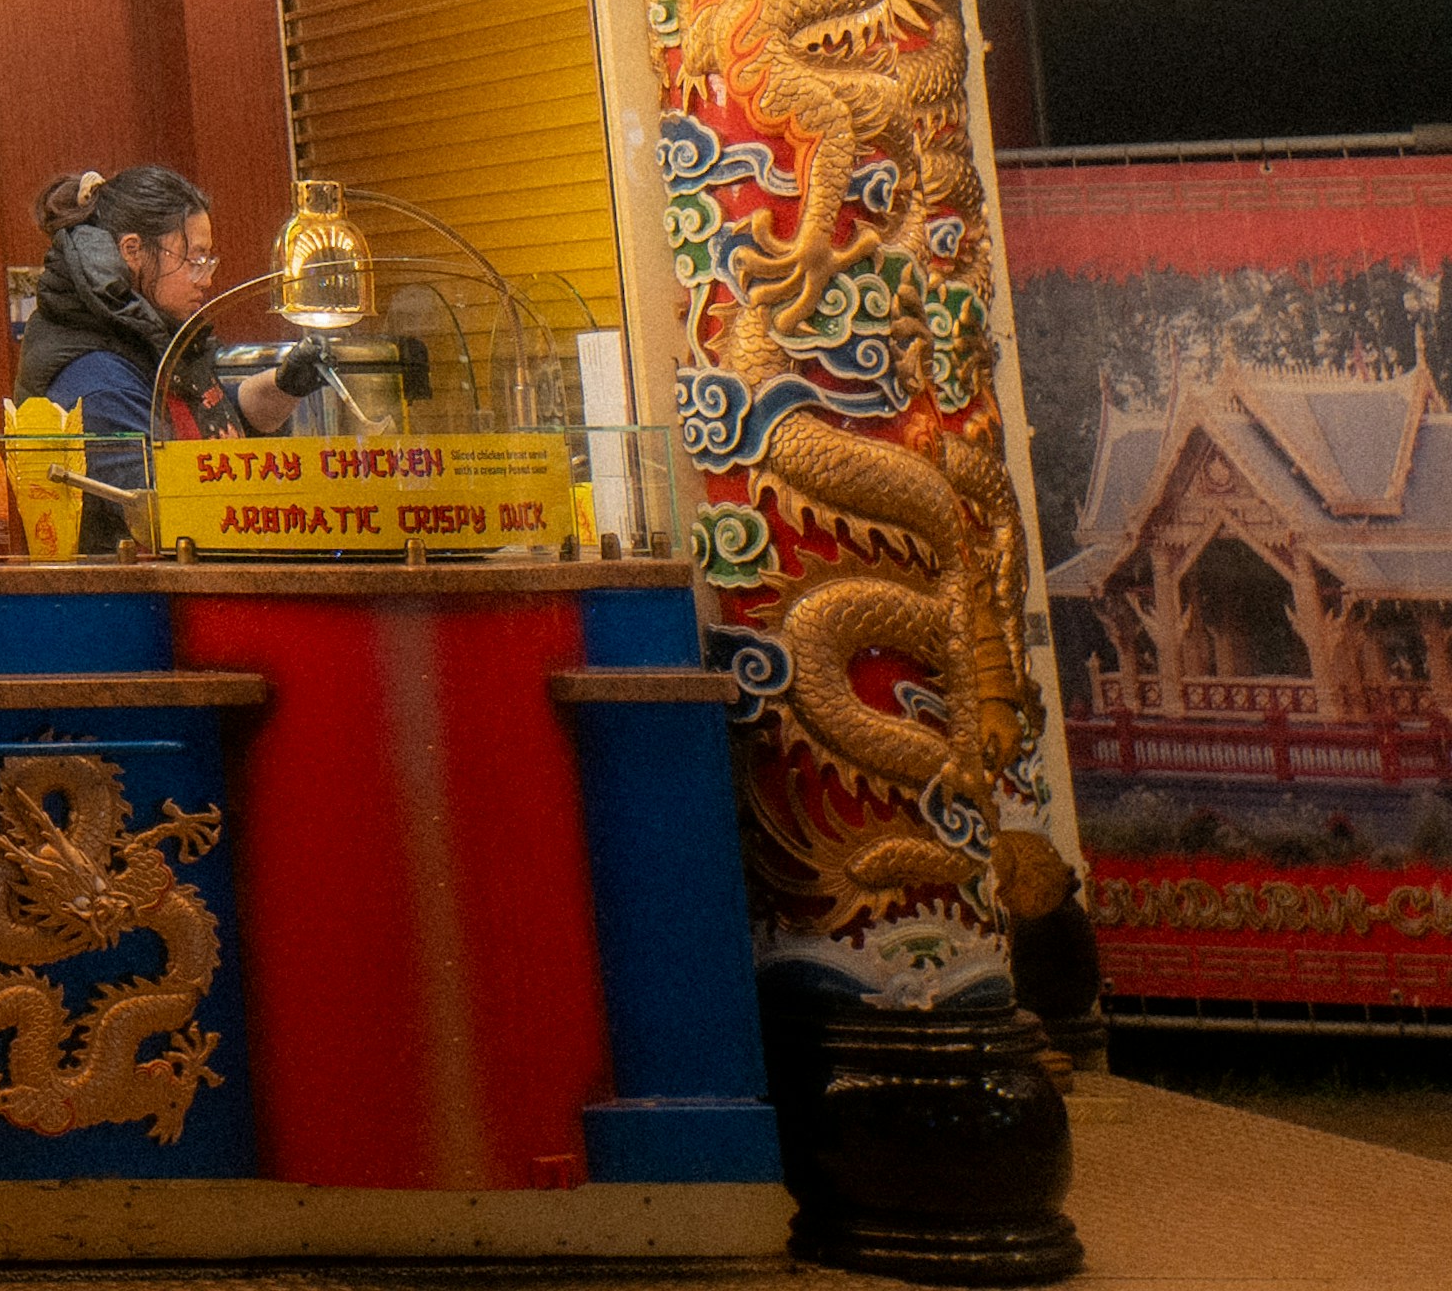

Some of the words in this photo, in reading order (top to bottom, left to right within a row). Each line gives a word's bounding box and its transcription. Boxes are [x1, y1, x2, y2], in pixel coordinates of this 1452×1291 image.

[196, 451, 302, 484] SATAY
[319, 447, 444, 480] CHICKEN
[220, 504, 381, 535] AROMATIC
[397, 503, 487, 535] CRISPY
[498, 501, 548, 533] DUCK
